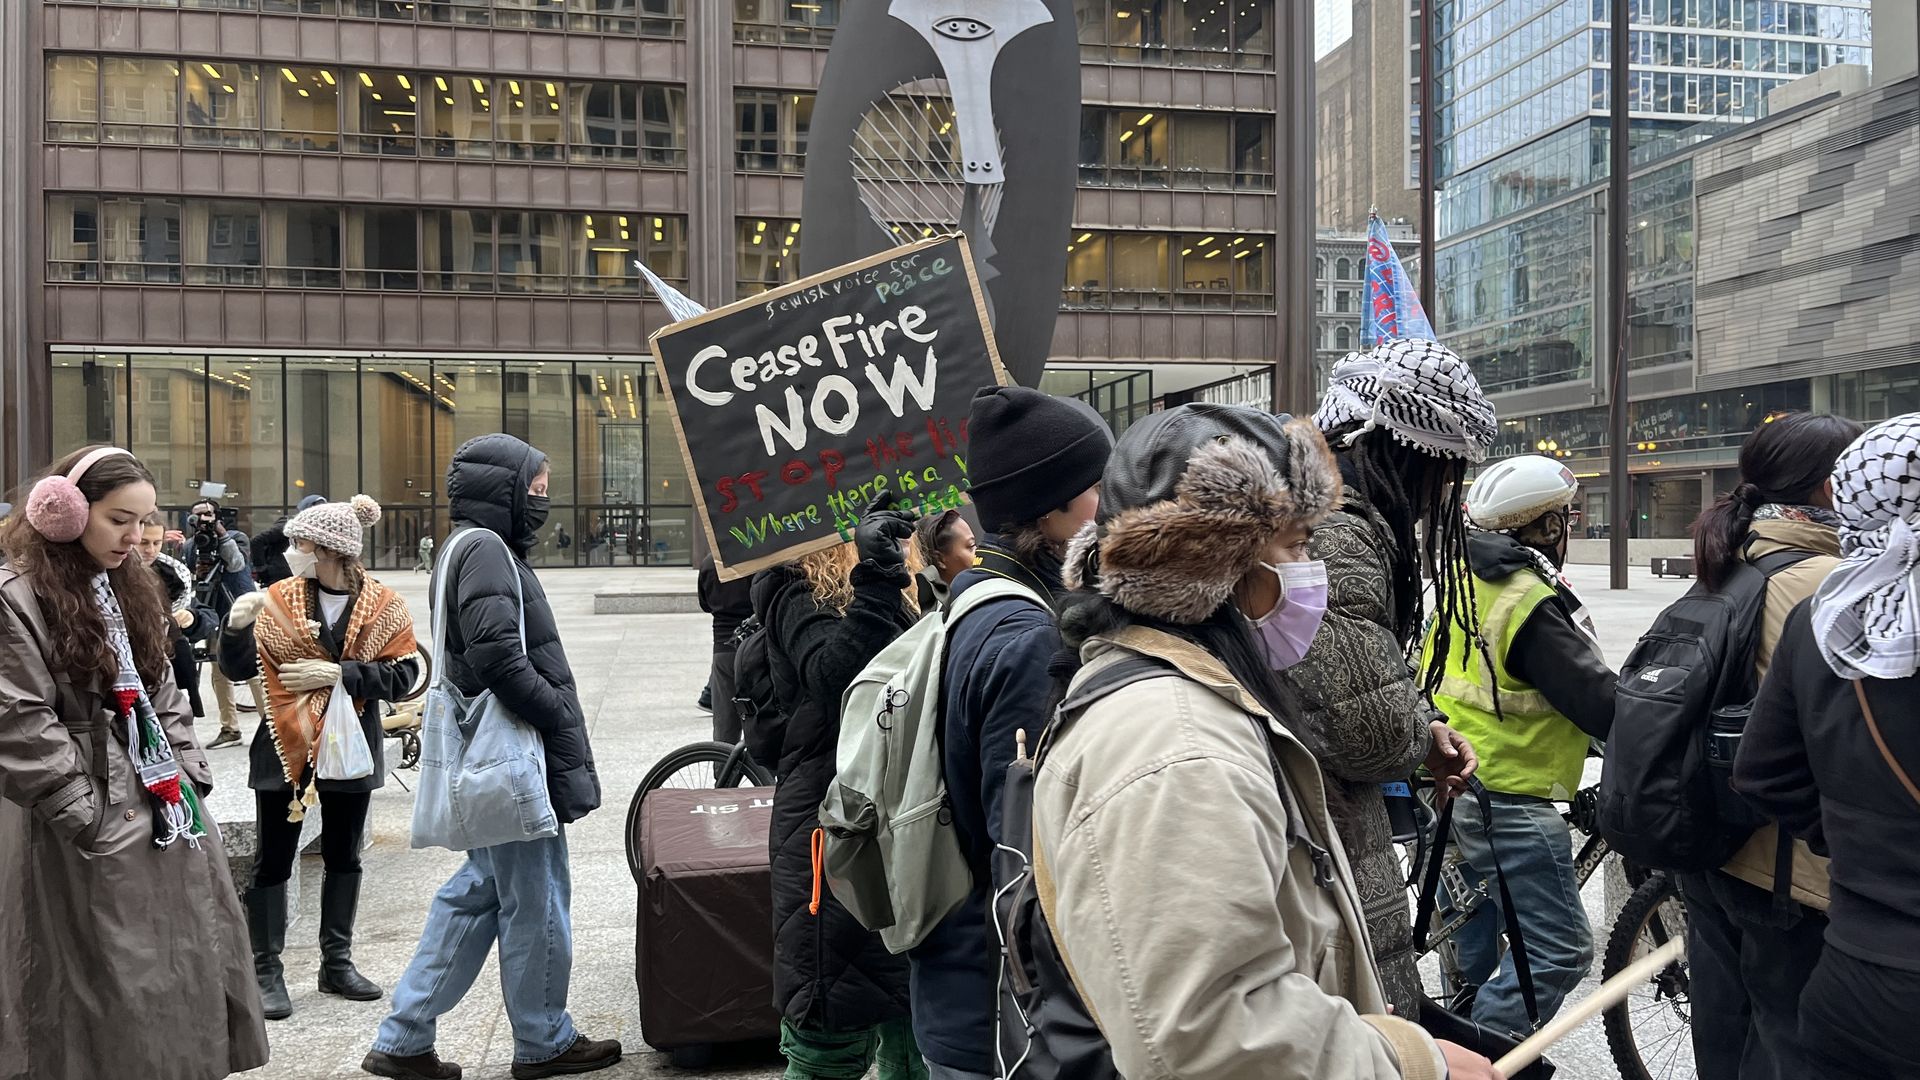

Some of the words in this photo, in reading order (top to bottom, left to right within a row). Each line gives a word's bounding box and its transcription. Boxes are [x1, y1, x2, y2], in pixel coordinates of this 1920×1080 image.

[890, 254, 920, 278] for
[755, 346, 937, 456] NOW
[716, 450, 846, 513] STOP
[729, 504, 822, 549] Where
[896, 469, 918, 493] is
[923, 466, 943, 482] a
[1576, 838, 1609, 884] GOOS
